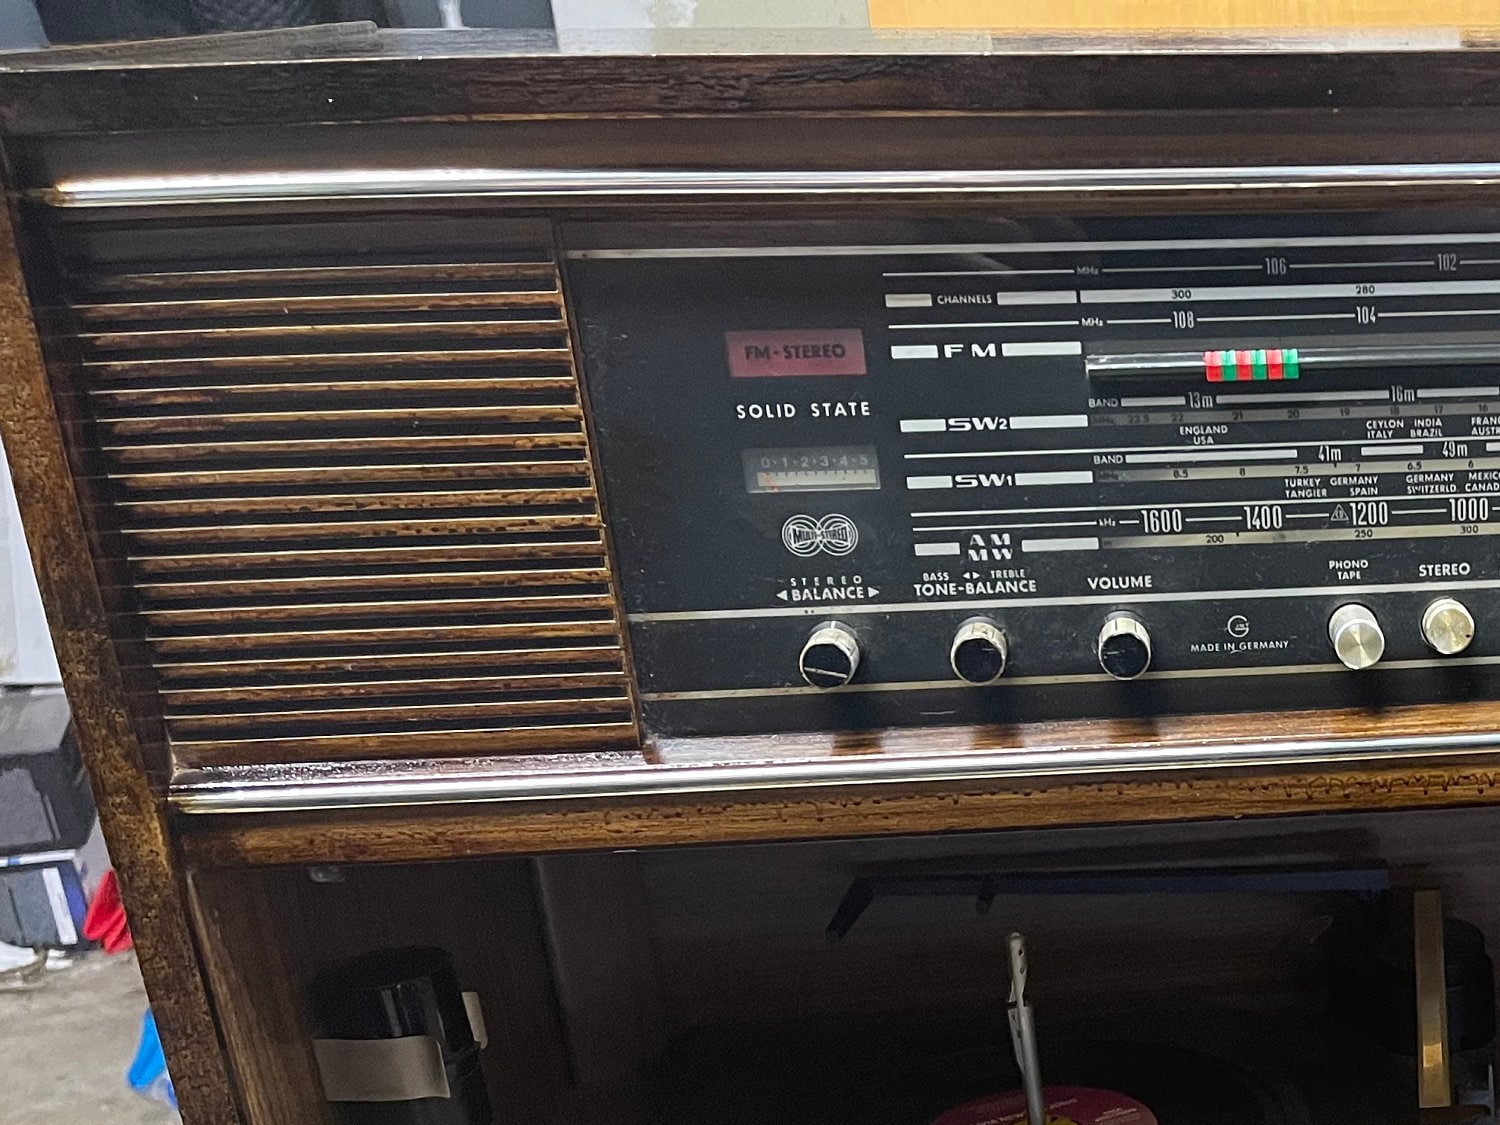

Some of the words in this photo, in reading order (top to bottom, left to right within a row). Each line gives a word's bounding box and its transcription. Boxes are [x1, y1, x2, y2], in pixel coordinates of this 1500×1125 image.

[1264, 256, 1287, 276] 106
[1437, 253, 1457, 271] 102
[937, 293, 992, 305] CHANNELS
[1172, 289, 1191, 300] 300
[1356, 285, 1376, 295] 280
[1173, 311, 1195, 329] 108
[1355, 306, 1377, 325] 104
[1088, 398, 1119, 408] BAND
[1188, 391, 1213, 408] 13m
[1391, 385, 1415, 403] 16m
[736, 404, 796, 419] SOLID
[811, 402, 870, 417] STATE
[1232, 411, 1243, 420] 21
[1287, 409, 1300, 419] 20
[1340, 408, 1350, 417] 19
[1434, 404, 1444, 414] 17
[1478, 403, 1488, 413] 16
[948, 416, 1008, 432] SW2
[1179, 425, 1228, 436] ENGLAND
[1366, 419, 1404, 429] CEYLON
[1414, 417, 1443, 427] INDIA
[1193, 436, 1214, 445] USA
[1367, 430, 1393, 439] ITALY
[1410, 428, 1443, 438] BRAZIL
[1093, 455, 1123, 464] BAND
[1318, 445, 1342, 462] 41m
[1442, 440, 1468, 458] 49m
[1294, 466, 1309, 475] 7.5
[1355, 463, 1361, 472] 7
[1407, 461, 1422, 470] 6.5
[1468, 460, 1474, 468] 6
[954, 473, 1013, 488] SW1
[1284, 478, 1321, 488] TURKEY
[1330, 475, 1378, 487] GERMANY
[1406, 473, 1454, 483] GERMANY
[1285, 488, 1328, 498] TANGIER
[1350, 486, 1378, 496] SPAIN
[1140, 508, 1182, 533] 1600
[1244, 505, 1282, 530] 1400
[1350, 501, 1388, 526] 1200
[1450, 498, 1489, 522] 1000
[1206, 534, 1224, 544] 200
[1354, 529, 1373, 538] 250
[1460, 525, 1479, 534] 300
[1329, 559, 1369, 570] PHONO
[1418, 562, 1471, 578] STEREO
[923, 572, 950, 581] BASS
[990, 569, 1026, 579] TREBLE
[1088, 575, 1152, 590] VOLUME
[1337, 570, 1361, 581] TAPE
[792, 586, 864, 601] BALANCE
[914, 580, 1037, 597] TONE-BALANCE
[1190, 643, 1220, 652] MADE
[1223, 642, 1235, 651] IN
[1239, 640, 1289, 650] GERMANY
